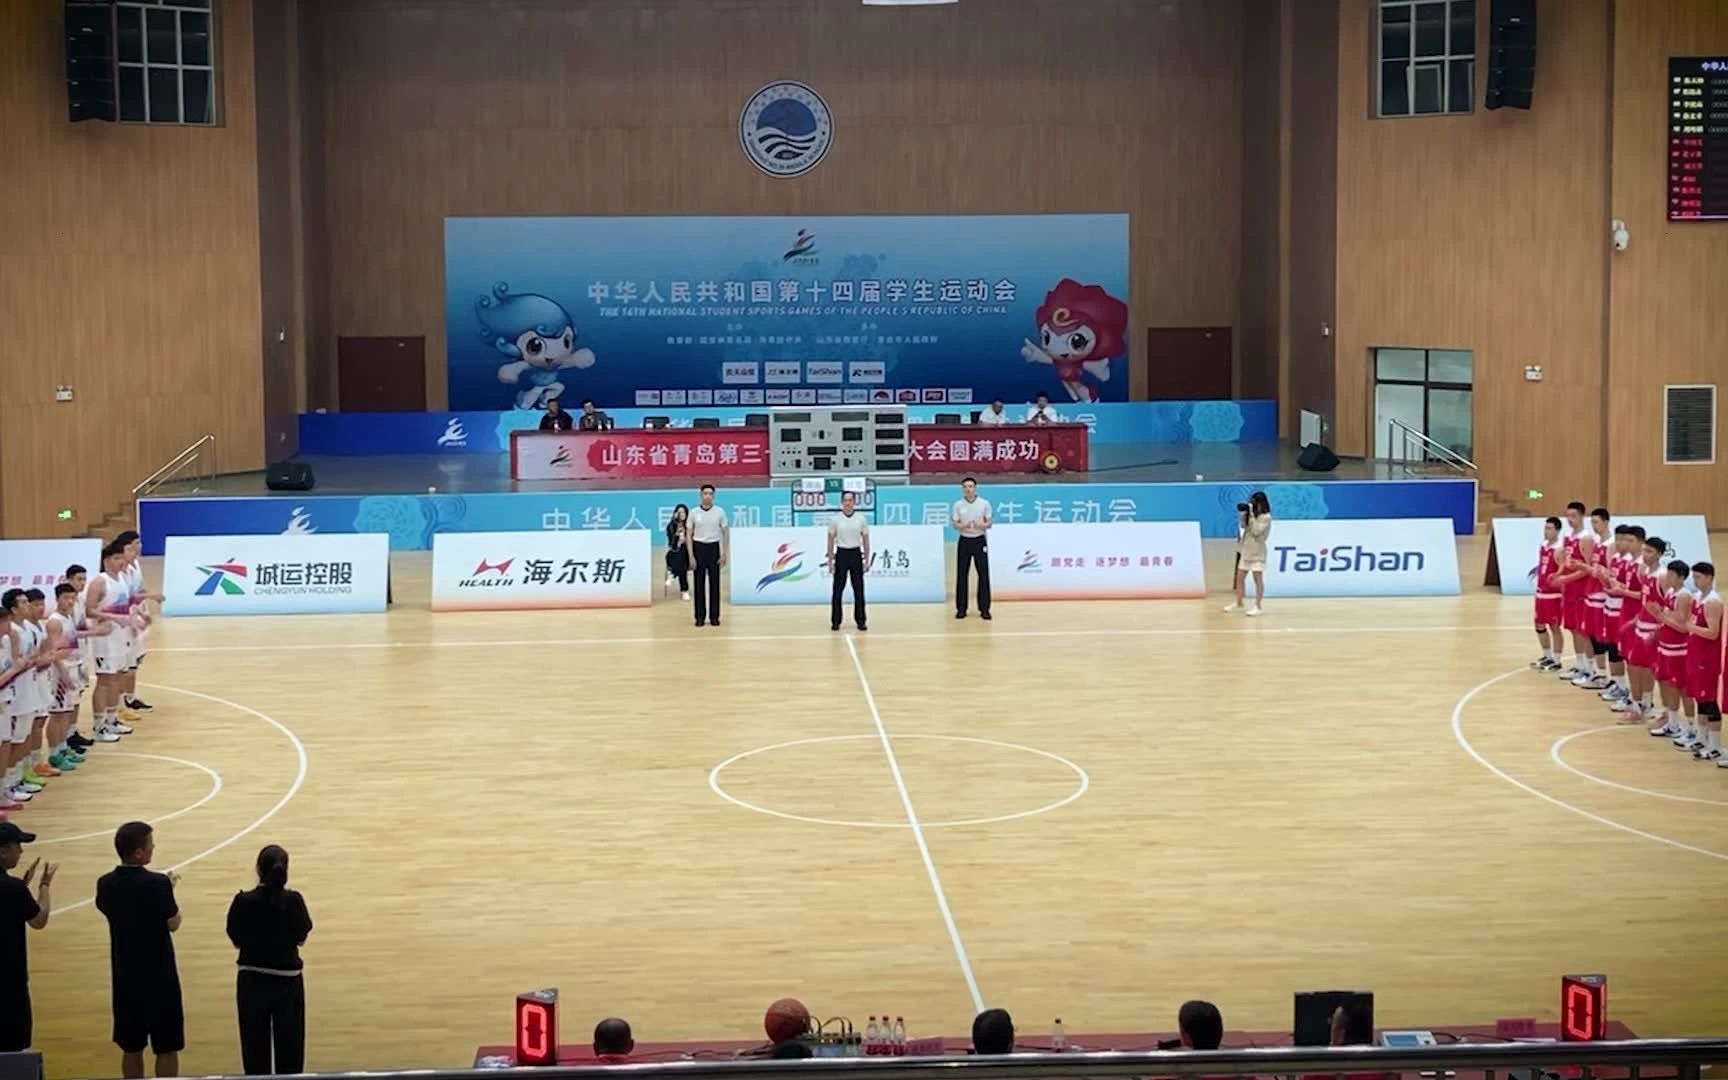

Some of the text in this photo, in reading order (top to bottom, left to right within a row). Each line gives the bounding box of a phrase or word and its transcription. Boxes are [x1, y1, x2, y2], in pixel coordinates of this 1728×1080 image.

[587, 279, 1016, 304] 中华人民共和国第十四届学生运动会
[648, 307, 697, 316] NATIONAL
[700, 306, 745, 316] STUDENT
[746, 306, 786, 316] SPORTS
[788, 306, 822, 315] GAMES
[839, 306, 858, 315] THE
[910, 306, 959, 315] REPUBLIC
[961, 305, 973, 314] OF
[976, 305, 1008, 314] CHINA
[602, 439, 1039, 466] 山东省青岛第三 大会圆满成功
[522, 558, 627, 585] 海尔斯
[1274, 545, 1425, 573] TaiShan
[255, 562, 353, 586] 城运控股
[459, 578, 515, 588] HEALTH
[309, 586, 353, 594] HOLDING
[1567, 984, 1592, 1040] 0
[522, 1003, 547, 1058] 0
